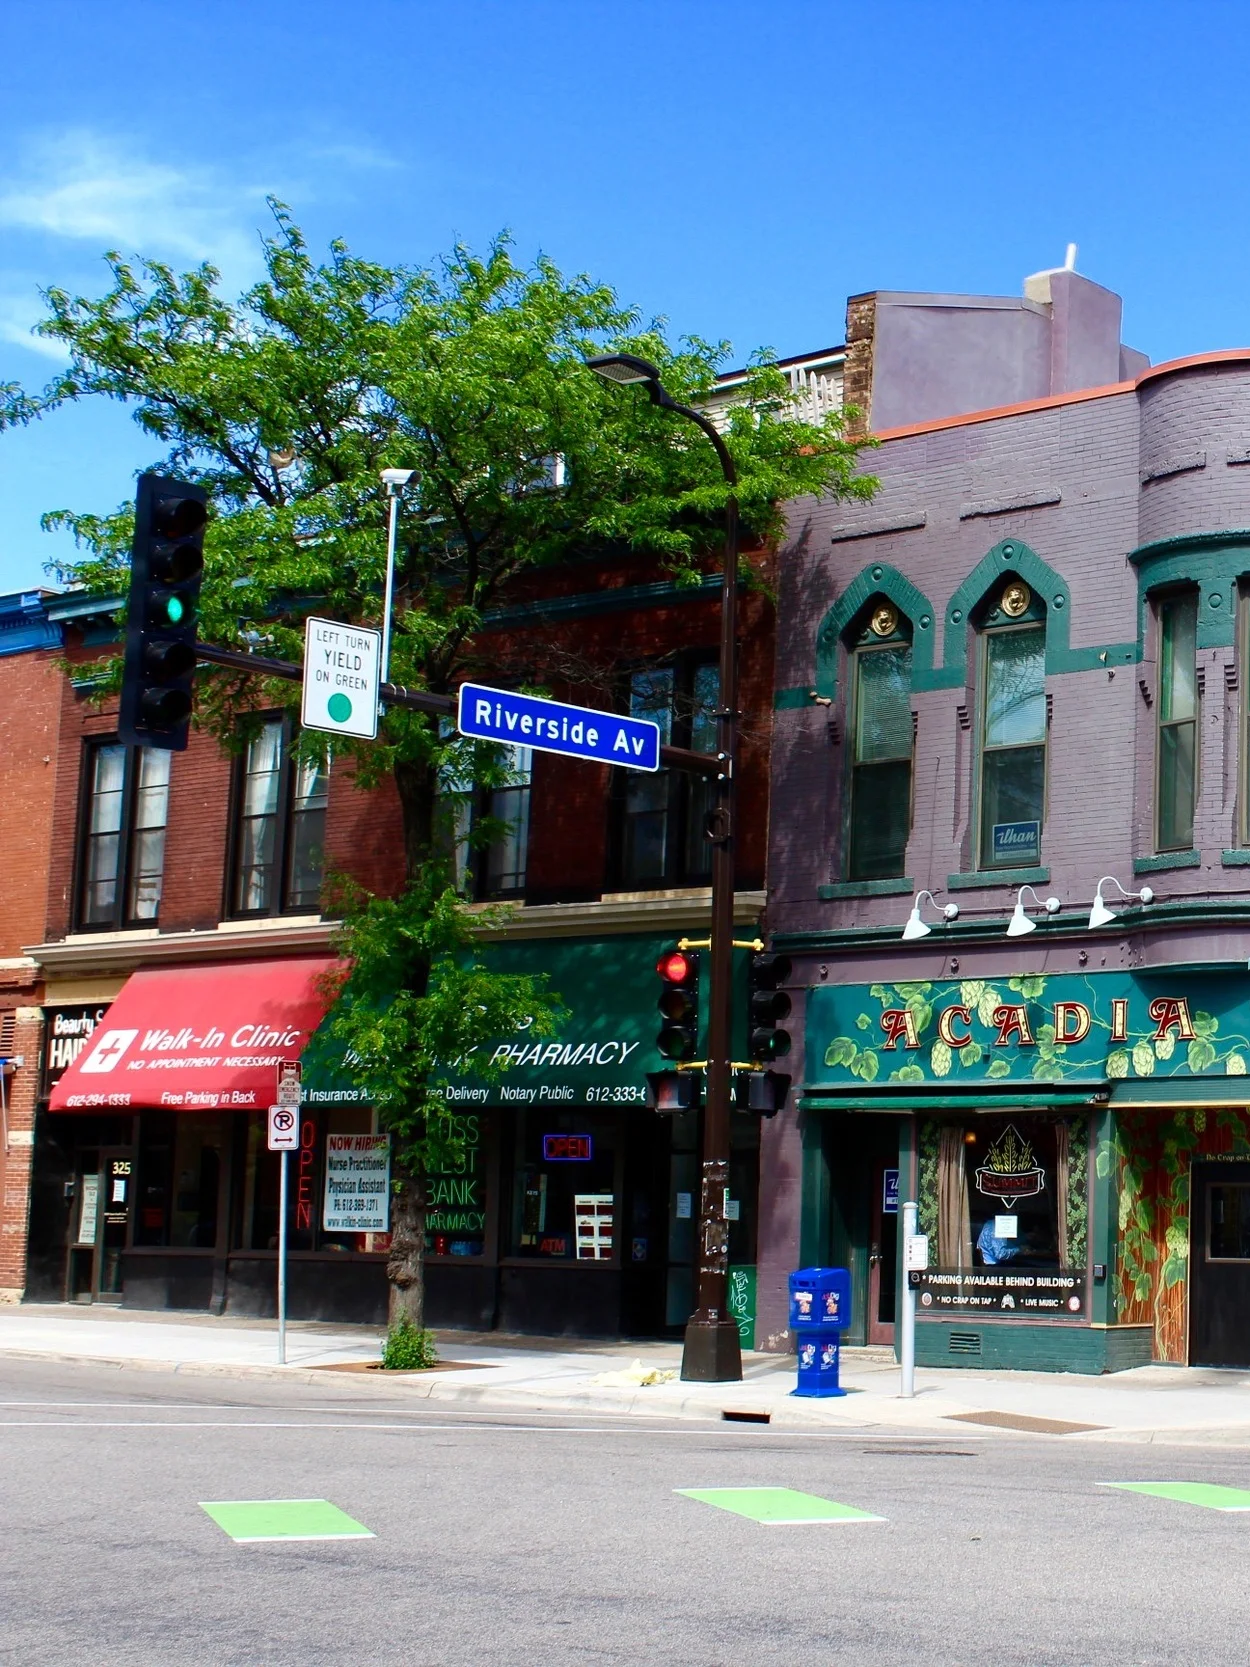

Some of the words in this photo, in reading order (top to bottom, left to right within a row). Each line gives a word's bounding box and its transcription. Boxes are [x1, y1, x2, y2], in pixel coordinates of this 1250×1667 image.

[316, 629, 339, 644] LEFT
[346, 635, 370, 651] TURN
[325, 649, 362, 671] YIELD
[316, 669, 329, 683] ON
[336, 674, 367, 690] GREEN
[475, 699, 598, 746] Riverside
[613, 729, 644, 756] Av
[54, 1011, 94, 1037] Beauty
[880, 997, 1197, 1050] ACADIA
[139, 1027, 225, 1051] Walk-In
[230, 1025, 300, 1048] Clinic
[488, 1041, 640, 1066] PHARMACY
[126, 1060, 144, 1071] NO
[148, 1057, 221, 1069] APPOINTMENT
[223, 1056, 285, 1067] NECESSARY
[161, 1091, 182, 1104] Free
[185, 1091, 218, 1107] Parking
[221, 1091, 230, 1104] in
[231, 1091, 255, 1104] Back
[310, 1089, 358, 1101] Insurance
[445, 1086, 489, 1102] Delivery
[500, 1087, 536, 1102] Notary
[540, 1085, 574, 1100] Public
[585, 1086, 646, 1102] 612-333-6
[329, 1136, 353, 1150] NOW
[546, 1138, 588, 1158] OPEN
[112, 1162, 132, 1174] 325
[328, 1156, 347, 1171] Nurse
[348, 1156, 386, 1171] Practitioner
[296, 1120, 316, 1229] OPEN
[328, 1178, 356, 1196] Physician
[357, 1178, 385, 1194] Assistant
[425, 1212, 486, 1231] HARMACY
[540, 1238, 566, 1252] ATM
[928, 1275, 962, 1285] PARKING
[964, 1276, 1003, 1286] AVAILABLE
[1006, 1276, 1035, 1287] BEHIND
[1036, 1277, 1074, 1288] BUILDING
[941, 1296, 951, 1304] NO
[952, 1296, 969, 1304] CRAP
[970, 1297, 980, 1305] ON
[980, 1297, 992, 1305] TAP
[1025, 1298, 1038, 1307] LIVE
[1039, 1299, 1059, 1307] MUSIC
